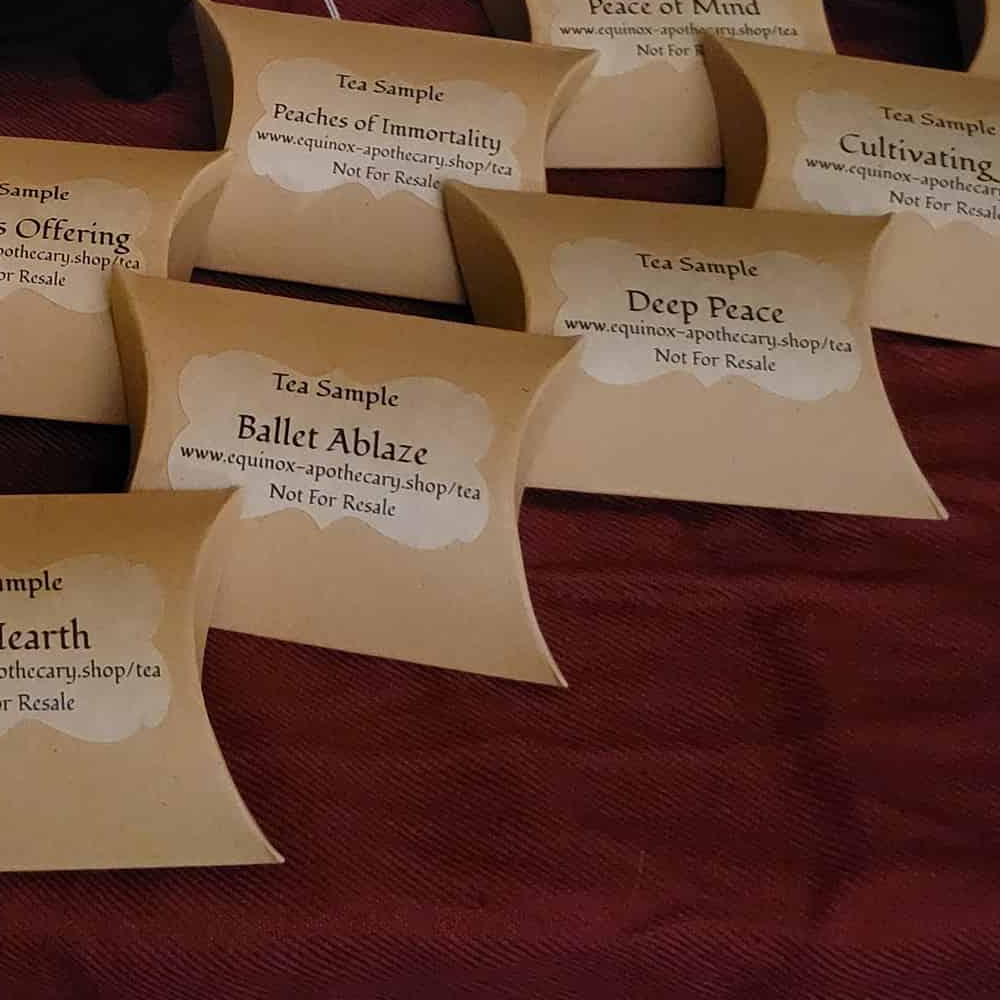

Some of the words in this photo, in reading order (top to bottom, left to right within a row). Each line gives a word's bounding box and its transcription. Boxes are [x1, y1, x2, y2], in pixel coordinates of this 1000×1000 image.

[637, 43, 665, 57] Not
[668, 44, 691, 57] For
[336, 73, 368, 92] Tea
[373, 79, 447, 104] Sample
[273, 103, 349, 129] Peaches
[354, 114, 379, 134] of
[382, 118, 501, 156] Immortality
[879, 105, 914, 123] Tea
[920, 112, 997, 137] Sample
[256, 130, 513, 177] www.equinox-apothecary.shop/tea
[839, 133, 1000, 183] Cultivating
[332, 160, 362, 179] Not
[366, 166, 390, 183] For
[394, 170, 441, 190] Resale
[805, 157, 1000, 202] www.equinox-apothecar
[889, 190, 921, 207] Not
[925, 196, 952, 212] For
[15, 217, 131, 254] Offering
[19, 269, 66, 287] Resale
[636, 253, 673, 271] Tea
[679, 256, 759, 281] Sample
[625, 289, 699, 324] Deep
[707, 296, 785, 324] Peace
[564, 319, 852, 354] www.equinox-apothecary.shop/tea
[654, 347, 687, 365] Not
[692, 352, 720, 368] For
[725, 353, 777, 372] Resale
[272, 372, 308, 395] Tea
[316, 379, 400, 410] Sample
[237, 413, 319, 449] Ballet
[327, 427, 428, 465] Ablaze
[180, 446, 481, 501] www.equinox-apothecary.shop/tea
[269, 483, 303, 504] Not
[309, 489, 337, 507] For
[343, 493, 396, 517] Resale
[18, 692, 75, 712] Resale
